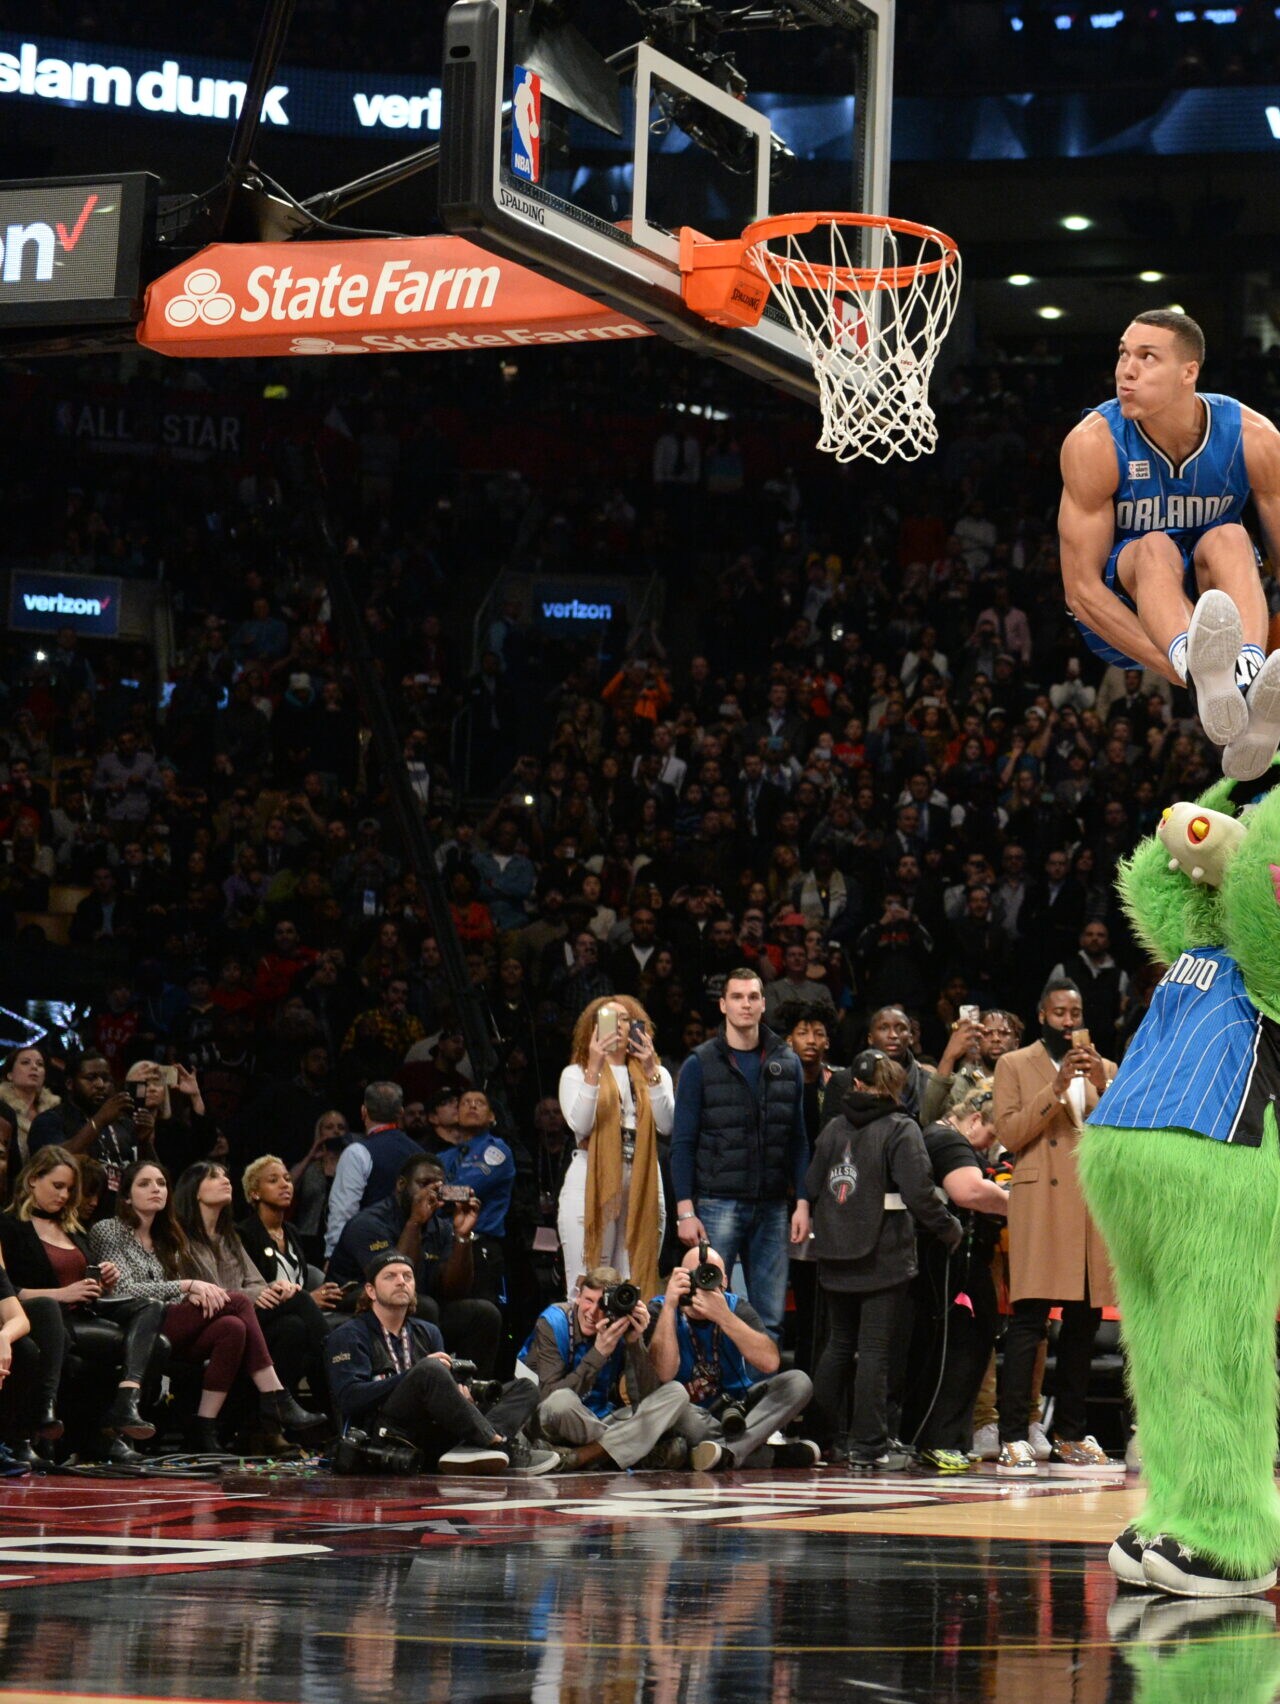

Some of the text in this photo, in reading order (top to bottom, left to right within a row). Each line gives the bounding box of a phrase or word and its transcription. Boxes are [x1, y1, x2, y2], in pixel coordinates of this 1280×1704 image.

[353, 88, 442, 131] veri
[513, 152, 531, 174] NBA
[500, 188, 545, 226] SPALDING
[0, 221, 56, 283] n
[240, 259, 501, 323] State Farm
[361, 324, 649, 353] State Farm
[162, 414, 241, 452] STAR
[1117, 495, 1234, 532] ORLANDO
[23, 592, 102, 616] verizon
[542, 598, 612, 620] verizon
[1158, 952, 1219, 992] NDO
